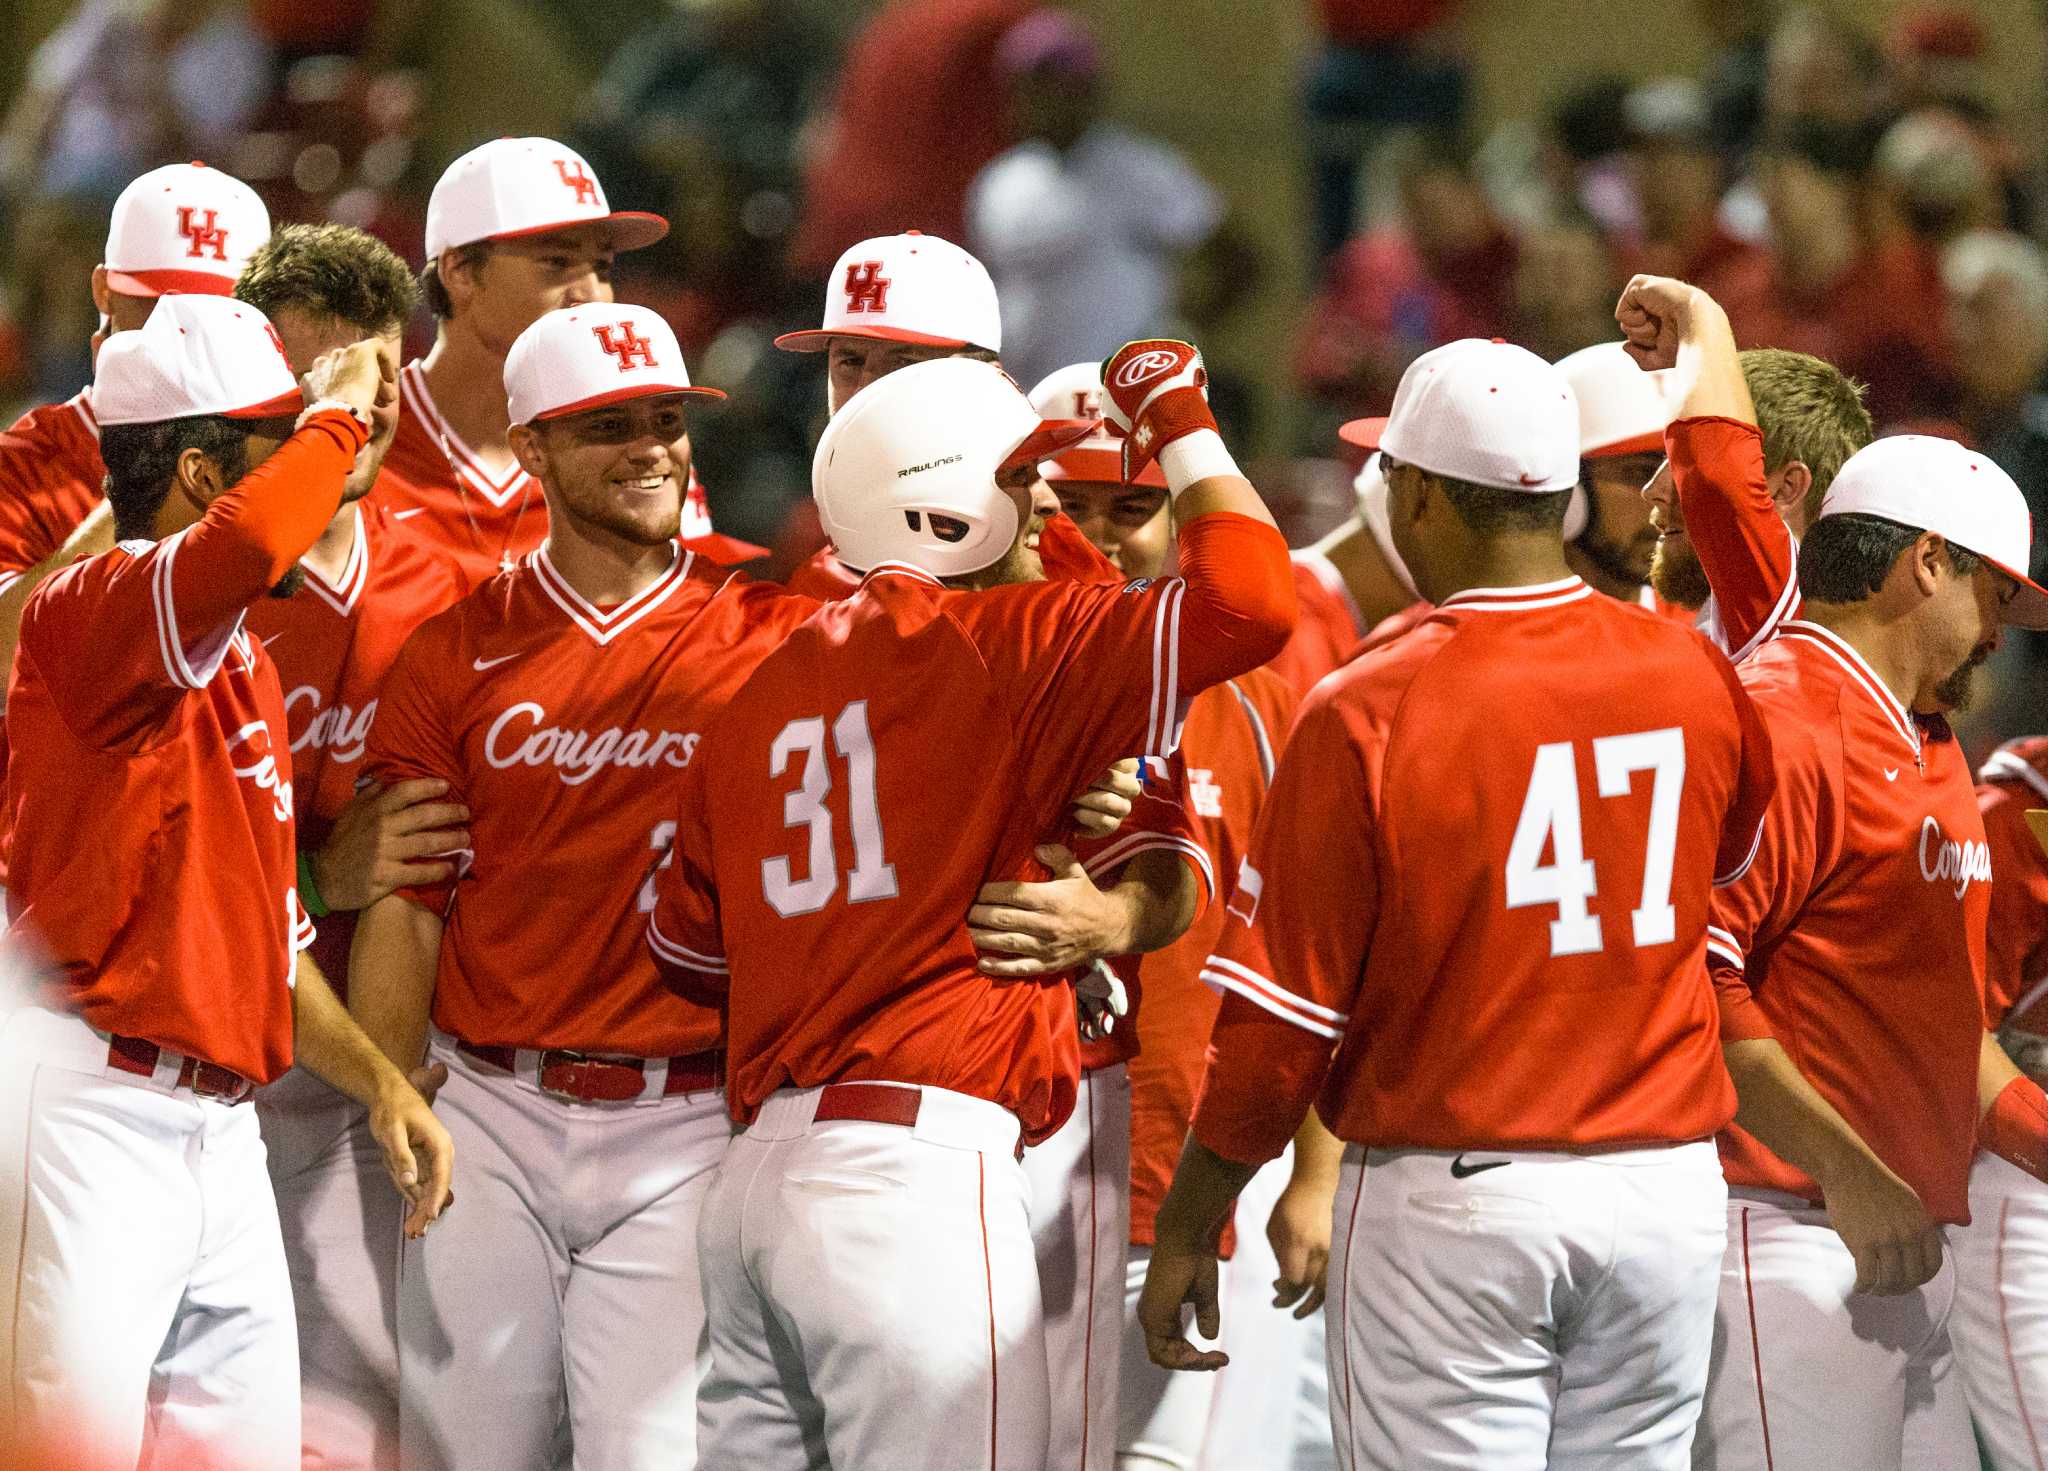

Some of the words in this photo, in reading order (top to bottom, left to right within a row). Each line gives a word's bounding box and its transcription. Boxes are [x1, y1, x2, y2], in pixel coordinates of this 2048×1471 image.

[552, 159, 601, 206] UH
[177, 206, 229, 261] UH
[845, 260, 891, 313] UH
[592, 320, 659, 373] UH
[897, 454, 963, 478] RAWLINGS
[485, 702, 701, 786] Cougars
[761, 696, 899, 919] 31
[1505, 726, 1686, 958] 47
